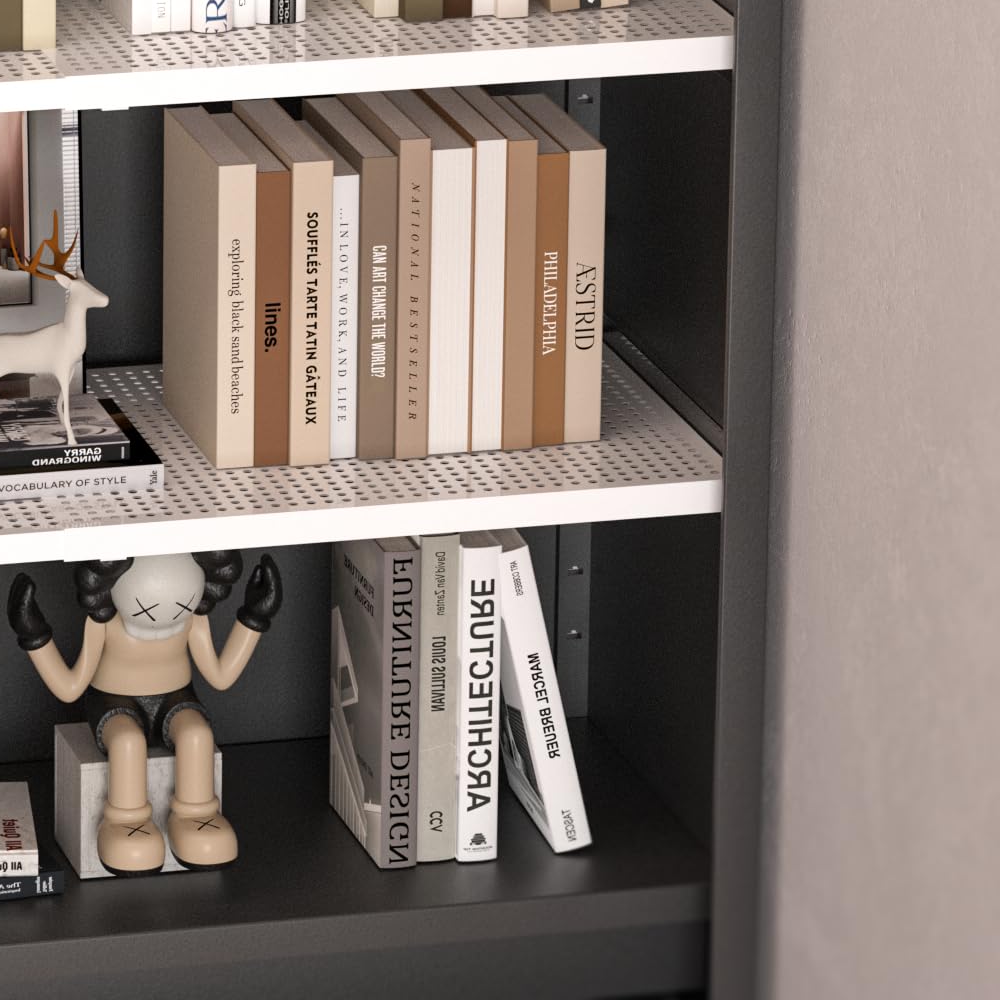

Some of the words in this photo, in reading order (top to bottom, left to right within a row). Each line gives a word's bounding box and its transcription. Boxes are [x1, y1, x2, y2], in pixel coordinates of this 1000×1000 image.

[307, 212, 321, 275] SOUFFLÉS
[410, 183, 421, 281] NATIONAL
[228, 239, 241, 297] exploring
[372, 267, 387, 282] ART
[373, 245, 387, 264] CAN
[231, 302, 244, 333] black
[307, 279, 318, 319] TARTE
[372, 286, 387, 321] CHANGE
[542, 252, 558, 356] PHILADELPHIA
[265, 303, 281, 352] lines.
[306, 323, 317, 360] TATIN
[371, 323, 386, 340] THE
[231, 336, 243, 366] sand
[371, 342, 386, 378] WORLD?
[409, 296, 419, 420] BESTSELLER
[231, 367, 244, 415] beaches
[305, 366, 319, 425] GÂTEAUX
